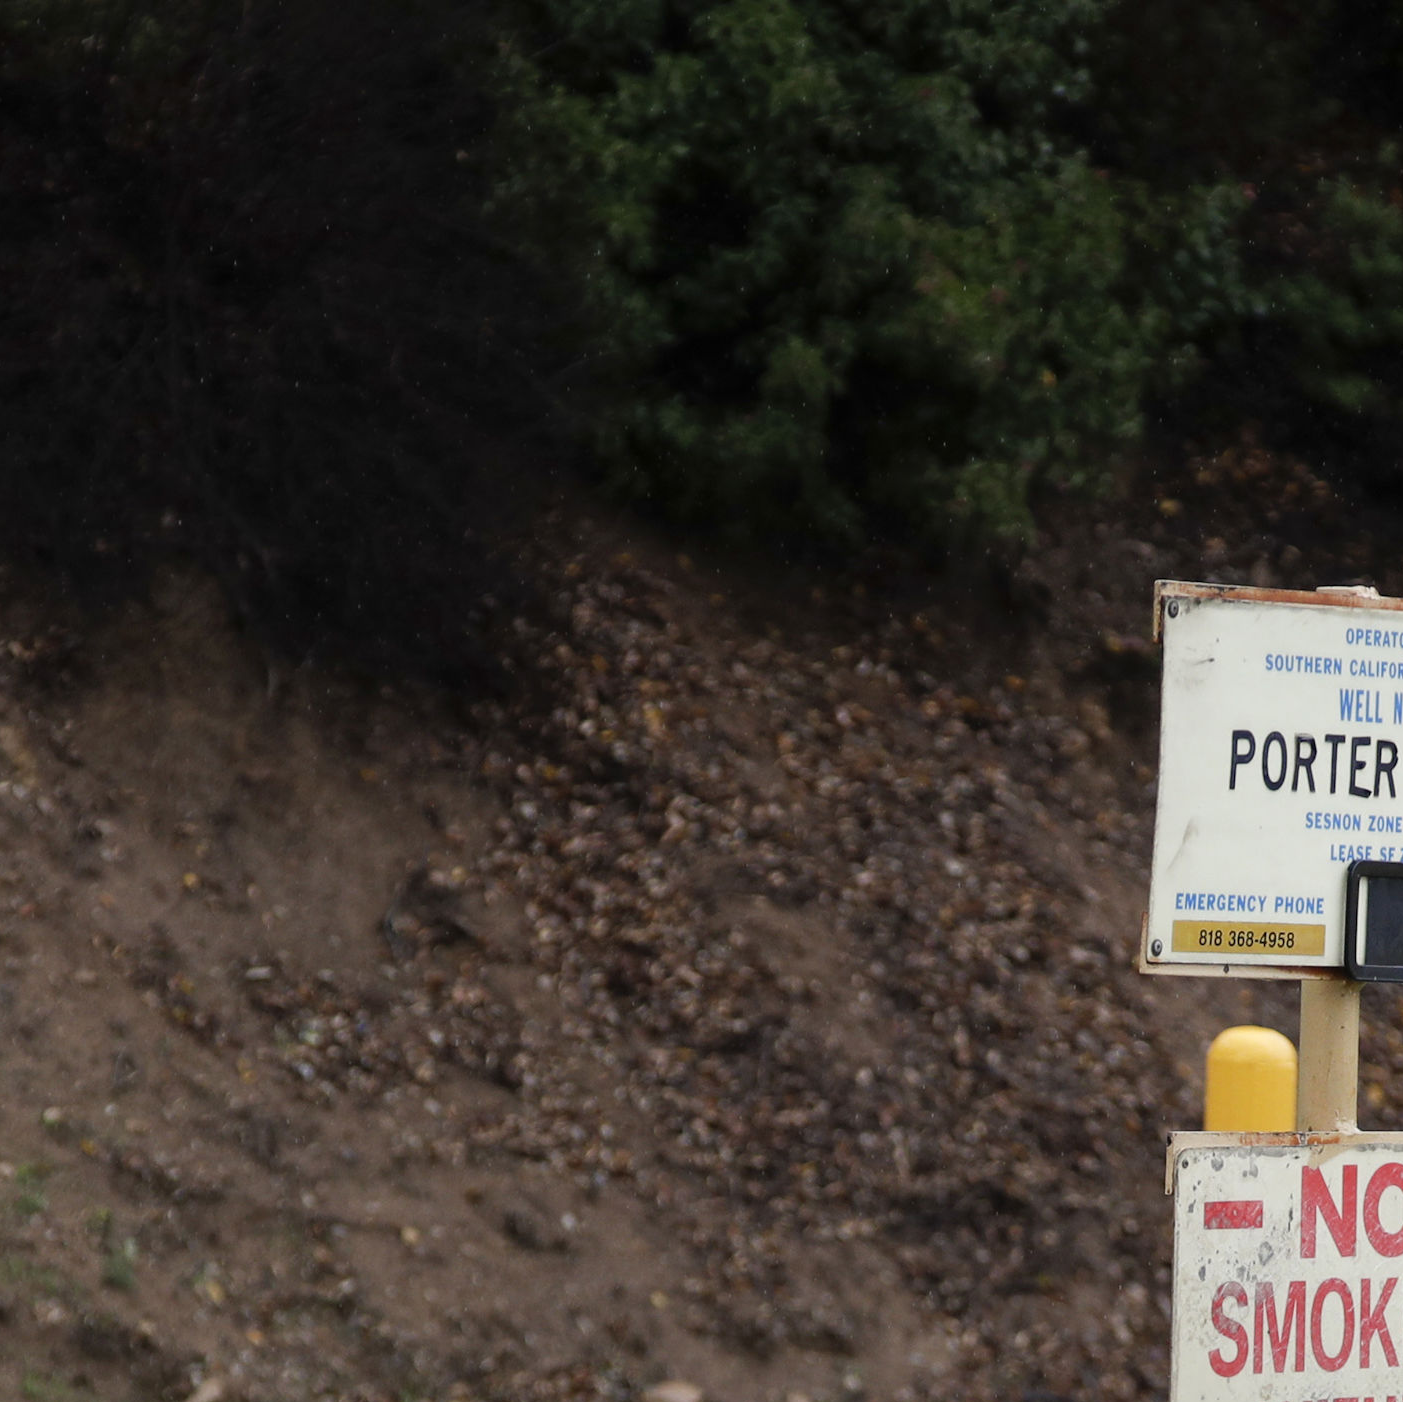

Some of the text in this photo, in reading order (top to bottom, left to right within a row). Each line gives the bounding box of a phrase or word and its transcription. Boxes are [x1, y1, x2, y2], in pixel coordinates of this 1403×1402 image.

[1265, 653, 1342, 675] SOUTHERN
[1340, 688, 1383, 724] WELL
[1229, 729, 1399, 799] PORTER
[1305, 811, 1362, 831] SESNON
[1368, 815, 1403, 833] ZONE
[1330, 844, 1373, 861] LEASE
[1175, 892, 1325, 914] EMERGENCY PHONE
[1198, 929, 1295, 948] 818 368-4958
